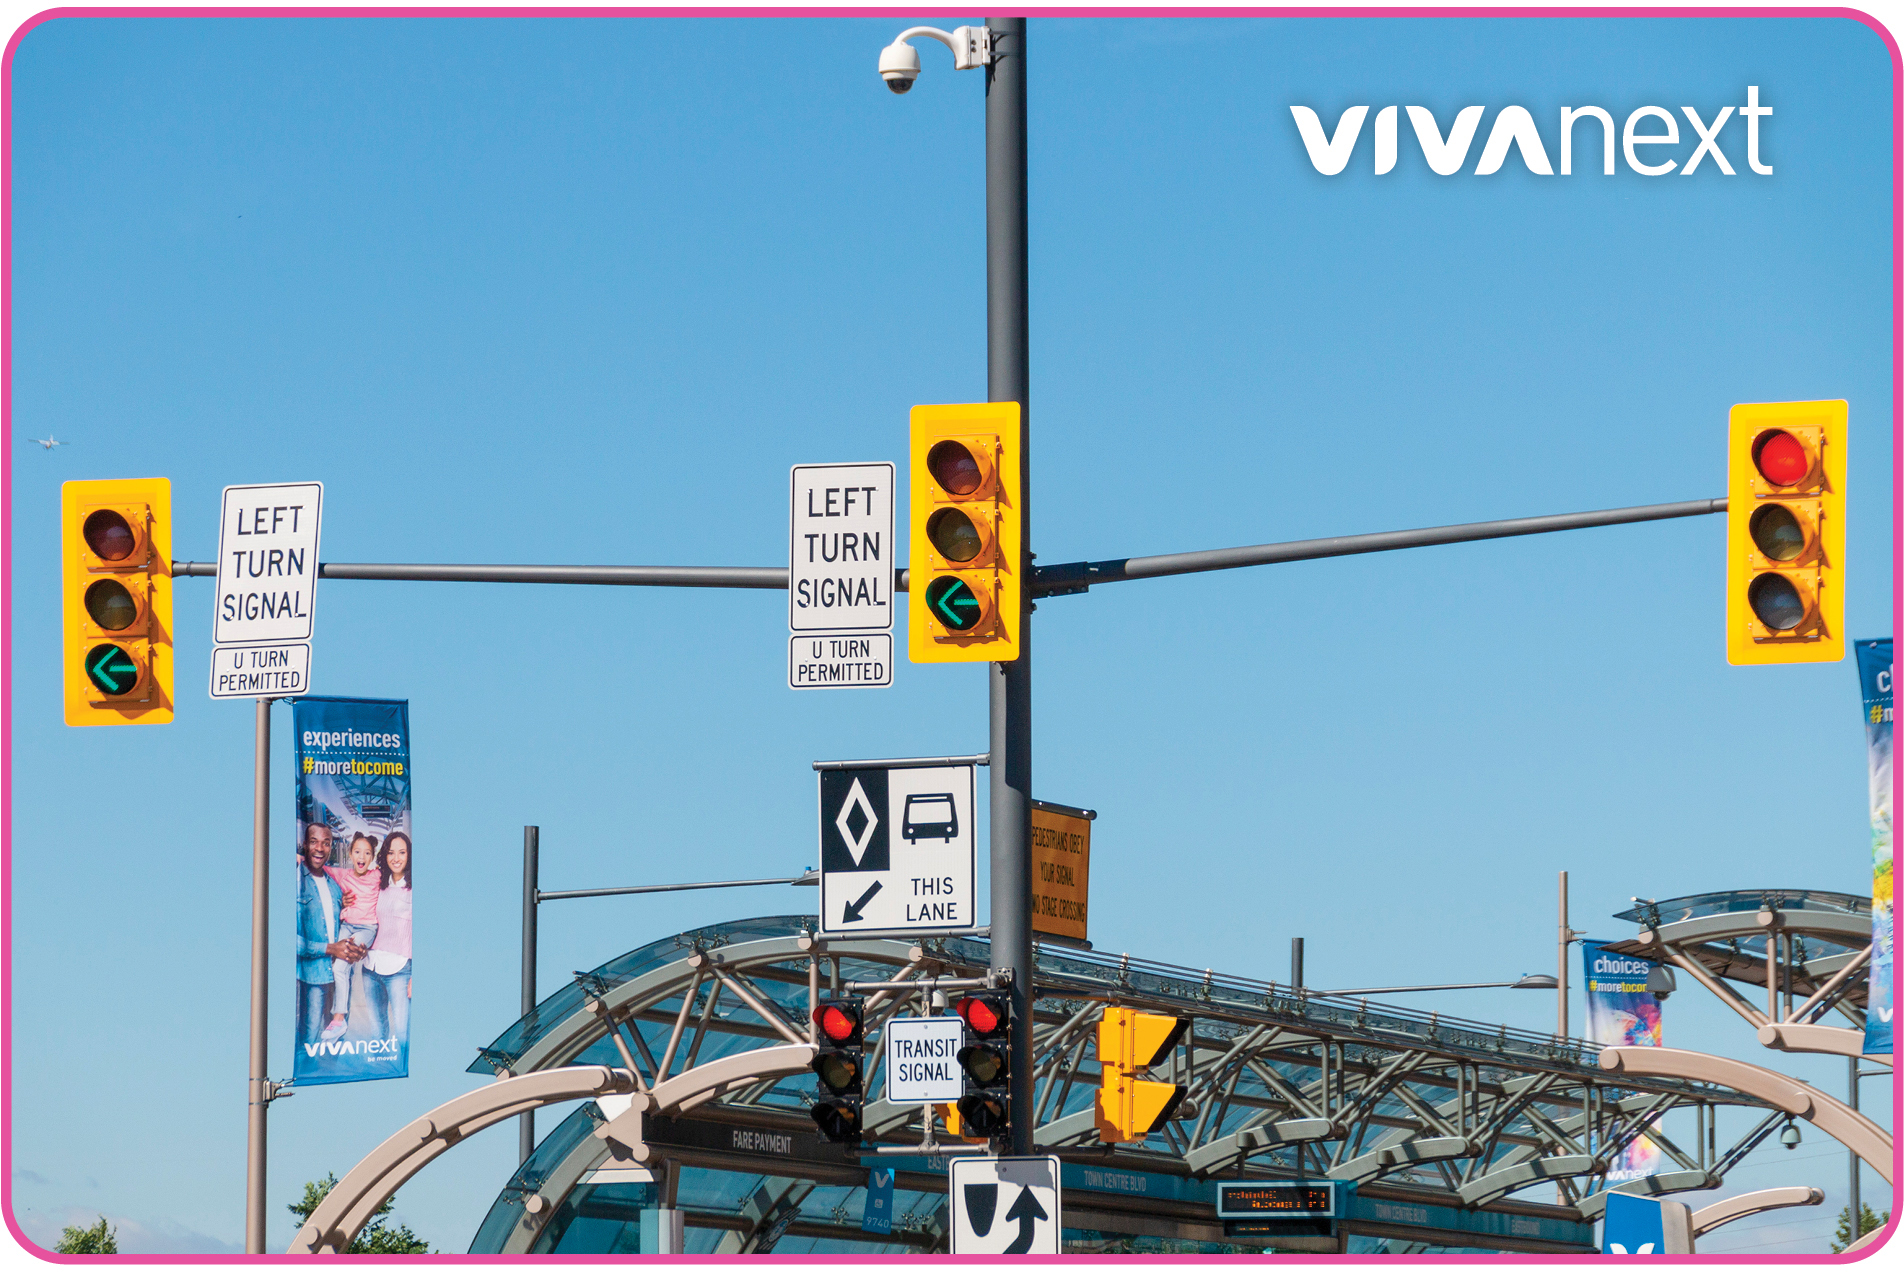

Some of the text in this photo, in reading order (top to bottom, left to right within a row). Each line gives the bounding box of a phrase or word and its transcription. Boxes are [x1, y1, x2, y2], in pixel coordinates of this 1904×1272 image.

[808, 486, 877, 518] LEFT
[237, 505, 304, 536] LEFT
[804, 531, 880, 563] TURN
[233, 547, 305, 578] TURN
[797, 577, 886, 608] SIGNAL
[222, 590, 307, 622] SIGNAL
[234, 650, 288, 669] U TURN
[812, 640, 870, 659] U TURN
[219, 671, 300, 692] PERMITTED
[798, 662, 883, 682] PERMITTED
[303, 728, 401, 751] experiences
[303, 756, 404, 775] #moretocome
[1032, 826, 1085, 855] PEDESTRIANS OBEY
[1040, 861, 1075, 887] YOUR SIGNAL
[910, 876, 954, 896] THIS
[906, 902, 958, 922] LANE
[1041, 895, 1058, 917] STAGE
[1060, 898, 1085, 923] CROSSING
[1593, 955, 1649, 974] choices
[895, 1038, 957, 1058] TRANSIT
[899, 1062, 953, 1082] SIGNAL
[733, 1130, 791, 1154] FARE PAYMENT
[1084, 1170, 1147, 1192] TOWN CENTRE BLVD
[867, 1216, 890, 1228] 9740
